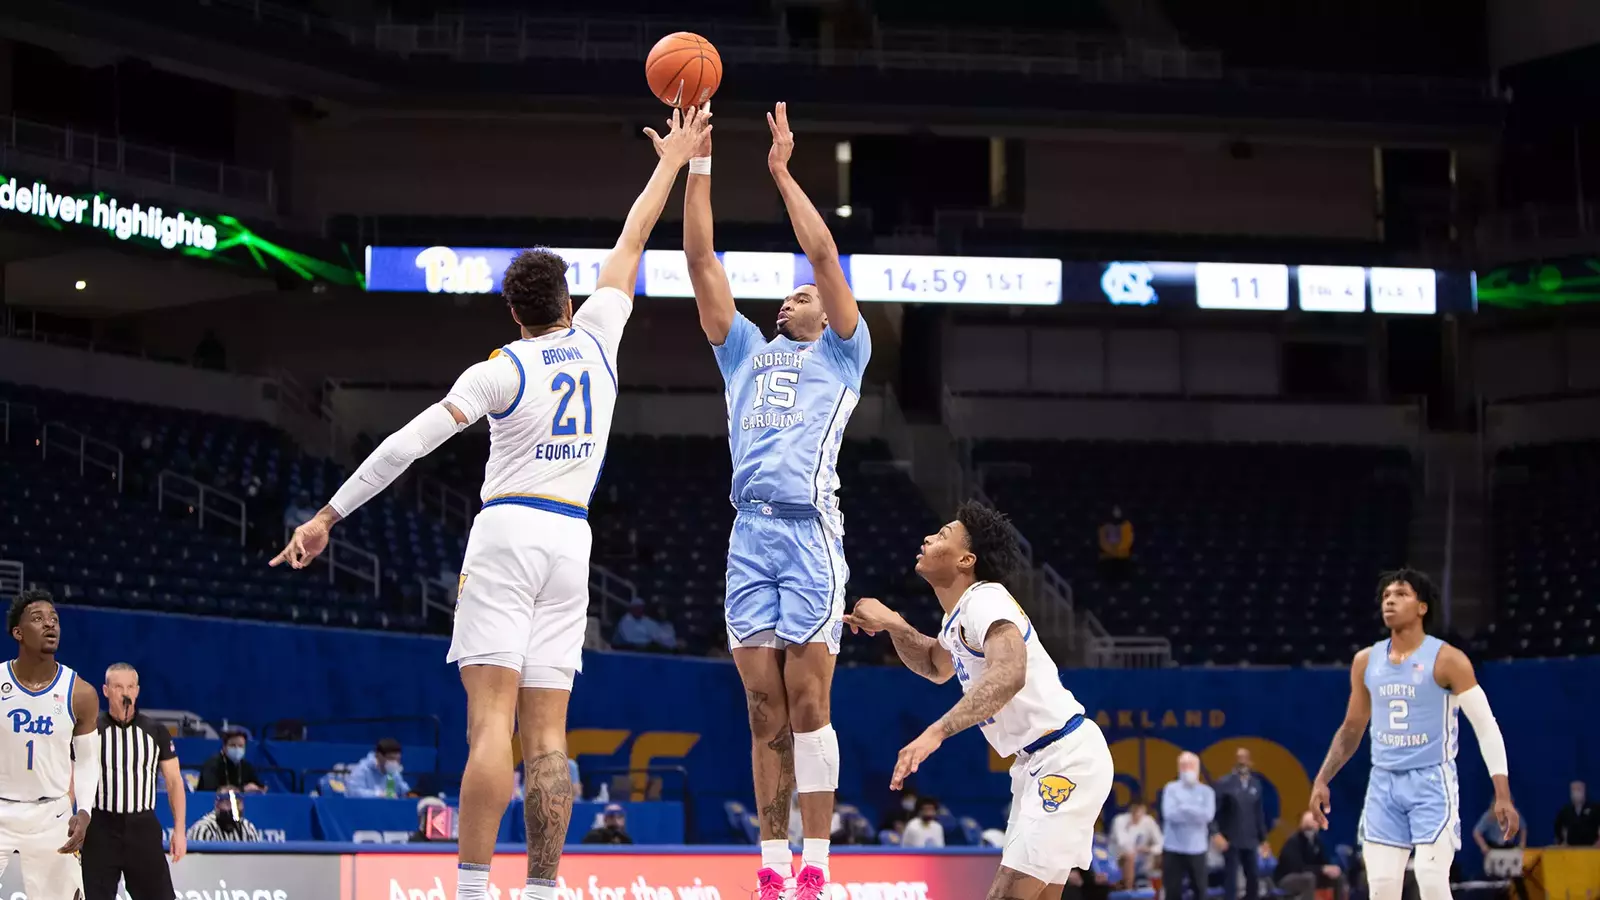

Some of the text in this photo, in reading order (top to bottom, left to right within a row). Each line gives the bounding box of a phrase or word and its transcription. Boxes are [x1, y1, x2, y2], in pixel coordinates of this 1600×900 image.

[0, 178, 217, 250] deliver highlights
[883, 268, 1025, 293] 14:59 1ST
[1230, 276, 1261, 300] 11
[541, 346, 583, 366] BROWN
[752, 352, 804, 370] NORTH
[753, 371, 800, 410] 15
[551, 370, 593, 437] 21
[741, 410, 804, 431] CAROLINA
[1379, 683, 1416, 699] NORTH
[7, 708, 54, 736] Pitt
[1095, 709, 1227, 728] AKLAND
[1388, 699, 1410, 731] 2
[1377, 731, 1429, 747] CAROLINA
[25, 739, 34, 771] 1
[389, 877, 447, 900] And
[630, 875, 674, 900] the
